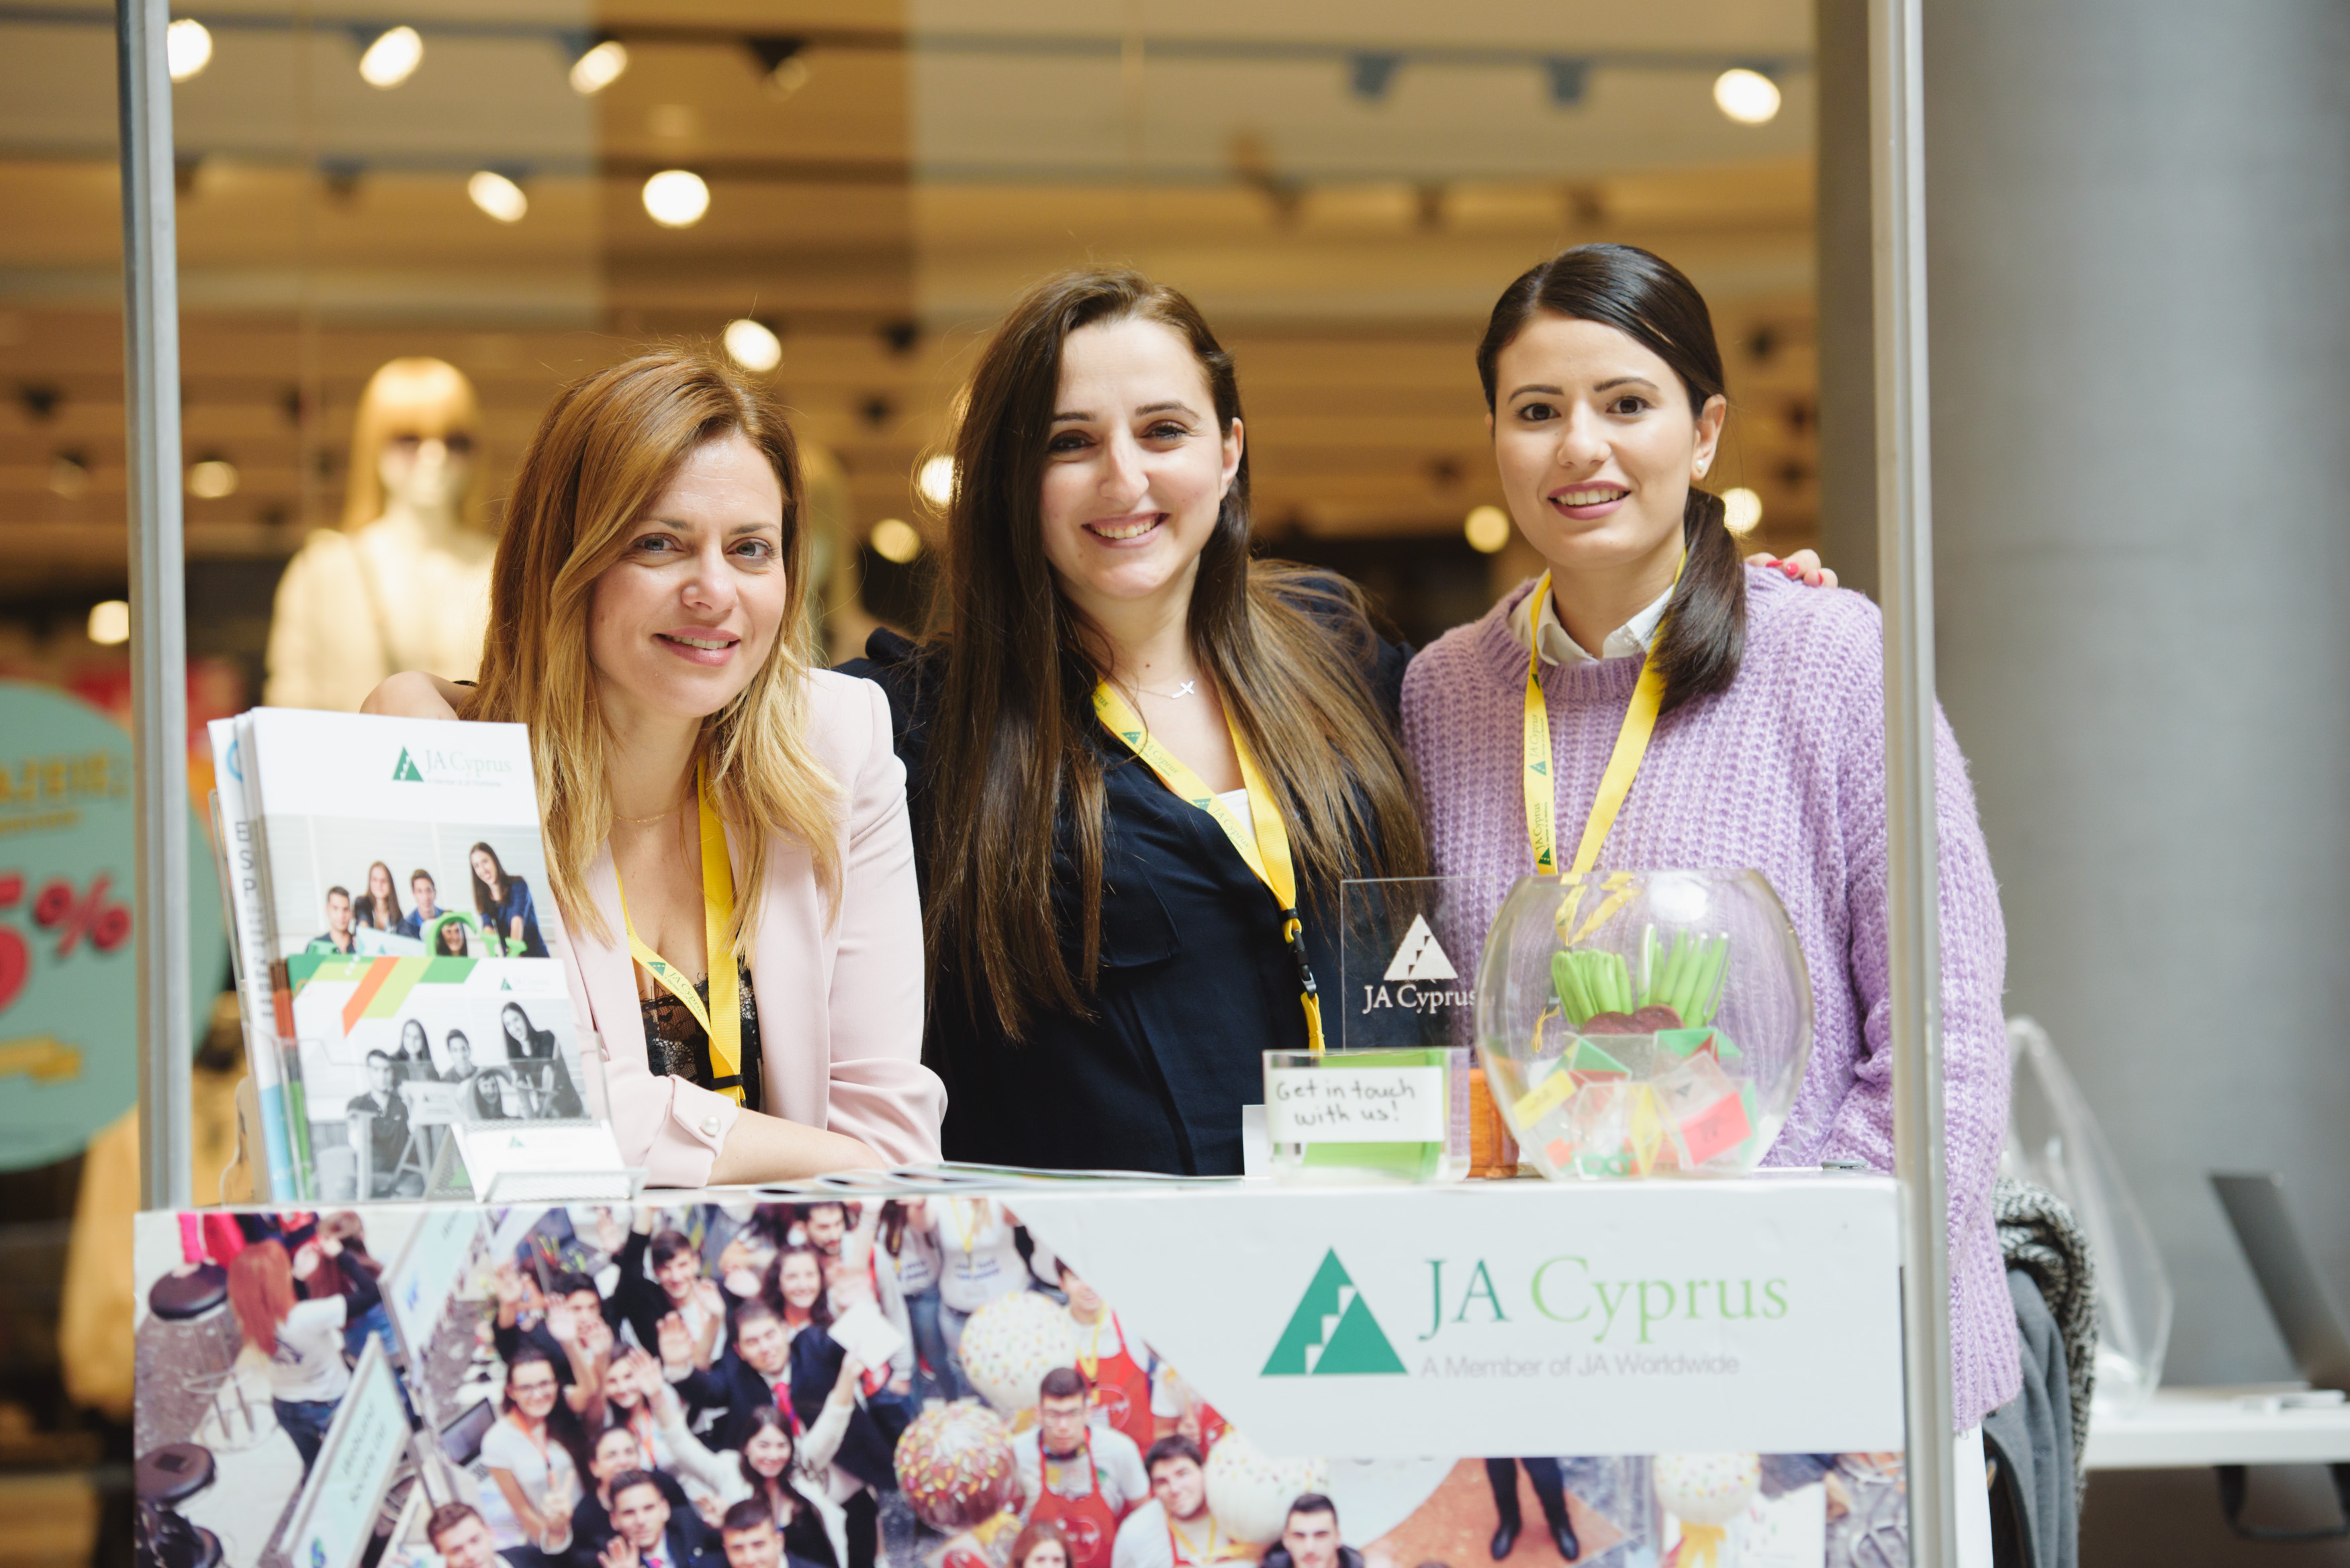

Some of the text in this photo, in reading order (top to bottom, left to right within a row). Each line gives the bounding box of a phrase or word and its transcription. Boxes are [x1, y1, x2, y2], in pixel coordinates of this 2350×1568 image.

[425, 749, 511, 777] JA Cyprus
[1223, 819, 1249, 847] Cyprus
[1533, 803, 1546, 850] JA Cyprus
[682, 983, 704, 1016] Cyprus
[1362, 983, 1476, 1014] JA Cyprus
[1276, 1077, 1415, 1101] Get in touch
[1295, 1100, 1399, 1126] with us!
[1417, 1255, 1789, 1344] JA Cyprus
[1421, 1352, 1741, 1377] A Member of JA Worldwide
